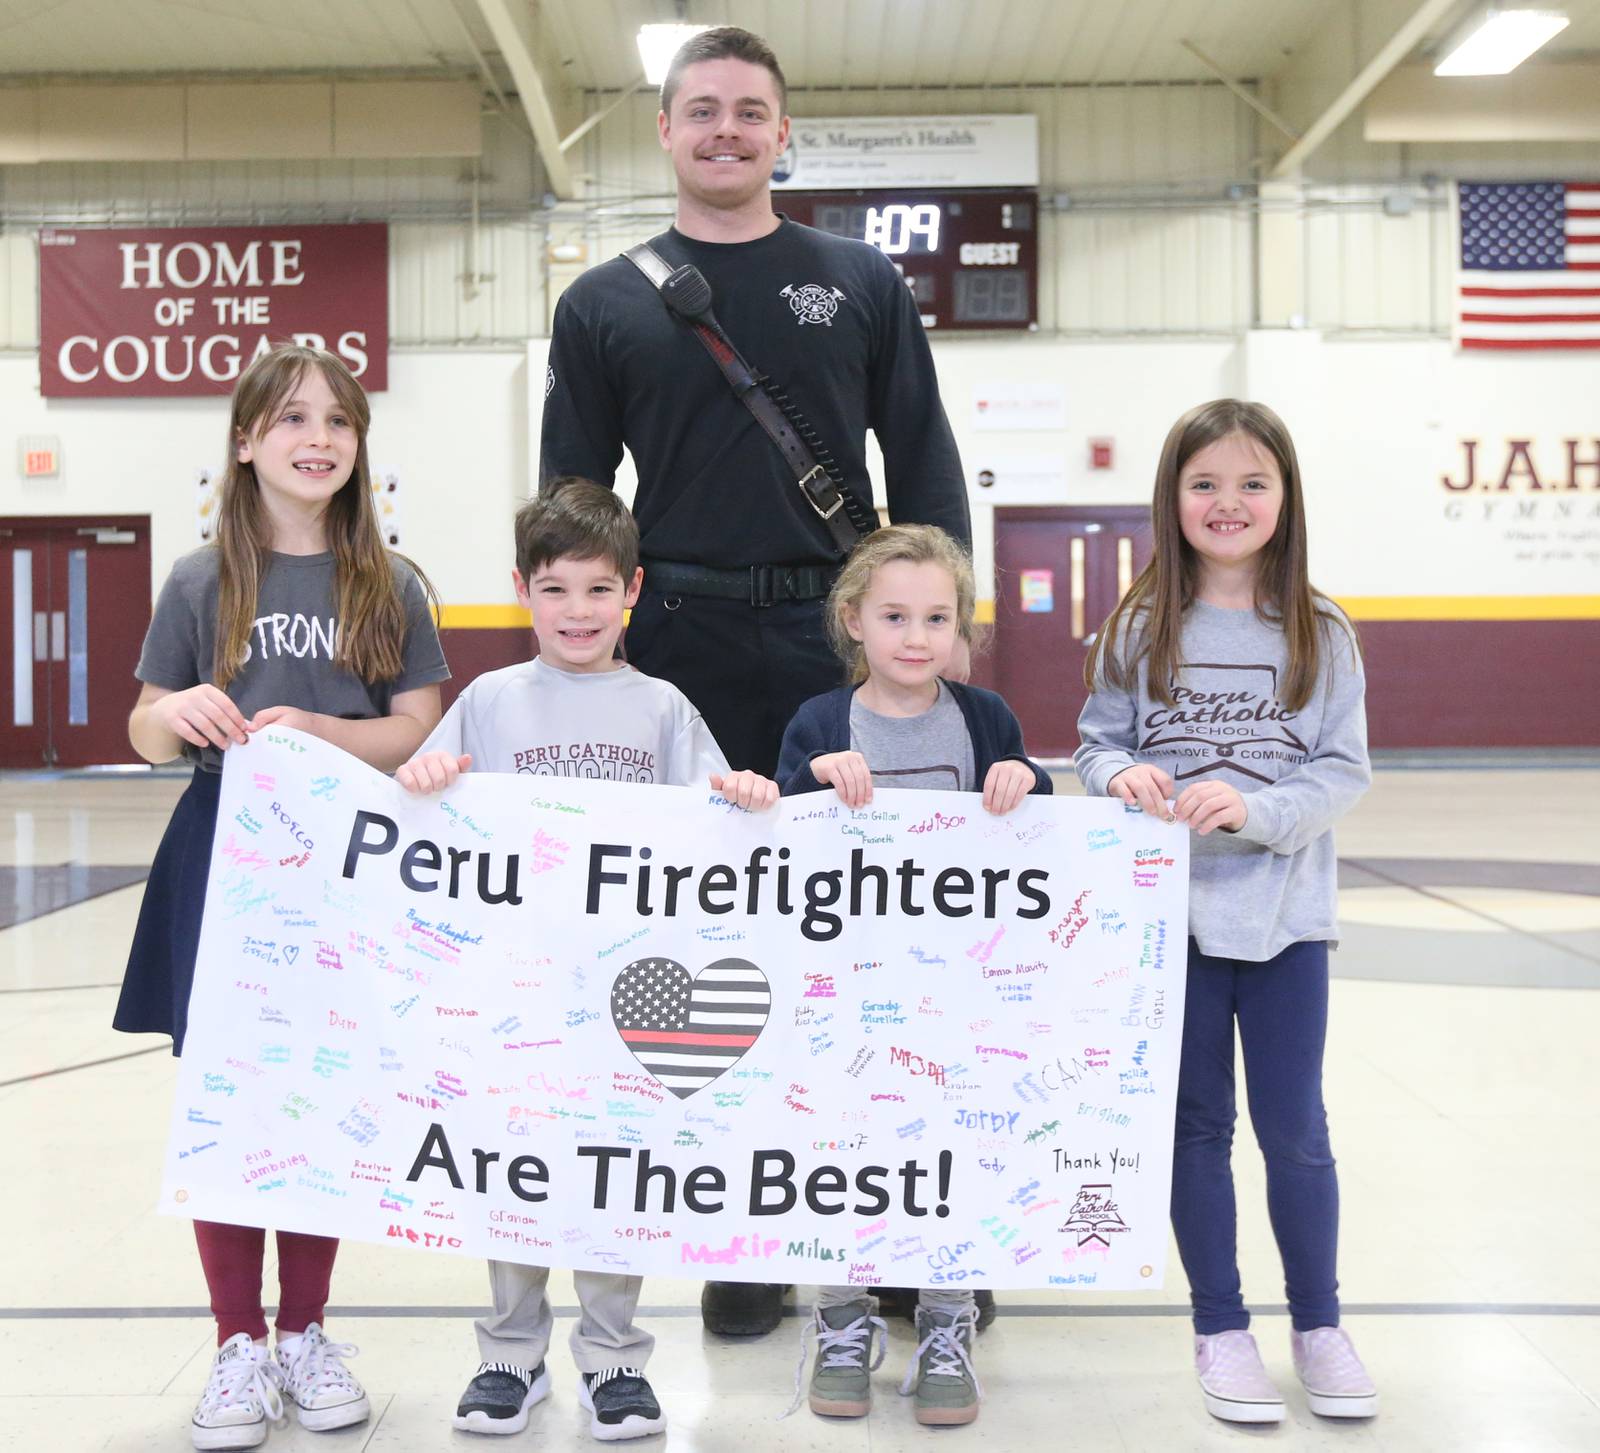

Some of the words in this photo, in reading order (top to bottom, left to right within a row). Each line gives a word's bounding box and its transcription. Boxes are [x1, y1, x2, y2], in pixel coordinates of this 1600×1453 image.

[827, 131, 914, 152] Margaret's
[919, 129, 976, 147] Health
[119, 240, 305, 289] HOME
[959, 242, 1020, 265] GUEST
[154, 298, 195, 326] OF
[212, 296, 270, 325] THE
[238, 613, 342, 665] TRON
[1171, 686, 1257, 706] Peru
[1145, 699, 1297, 729] Catholic
[1184, 726, 1261, 737] SCHOOL
[514, 745, 561, 768] PERU
[569, 743, 655, 769] CATHOLIC
[851, 810, 868, 820] Leo
[342, 810, 523, 906] Peru
[586, 843, 1051, 941] Firefighters
[1096, 908, 1120, 920] Noah
[982, 966, 1012, 979] Emma
[862, 1000, 903, 1015] Grady
[406, 1123, 549, 1203] Are
[578, 1147, 726, 1213] The
[748, 1150, 953, 1217] Best!
[1052, 1148, 1103, 1173] Thank
[1110, 1147, 1140, 1174] You!
[1070, 1200, 1118, 1215] Catholic
[1076, 1191, 1102, 1203] Peru
